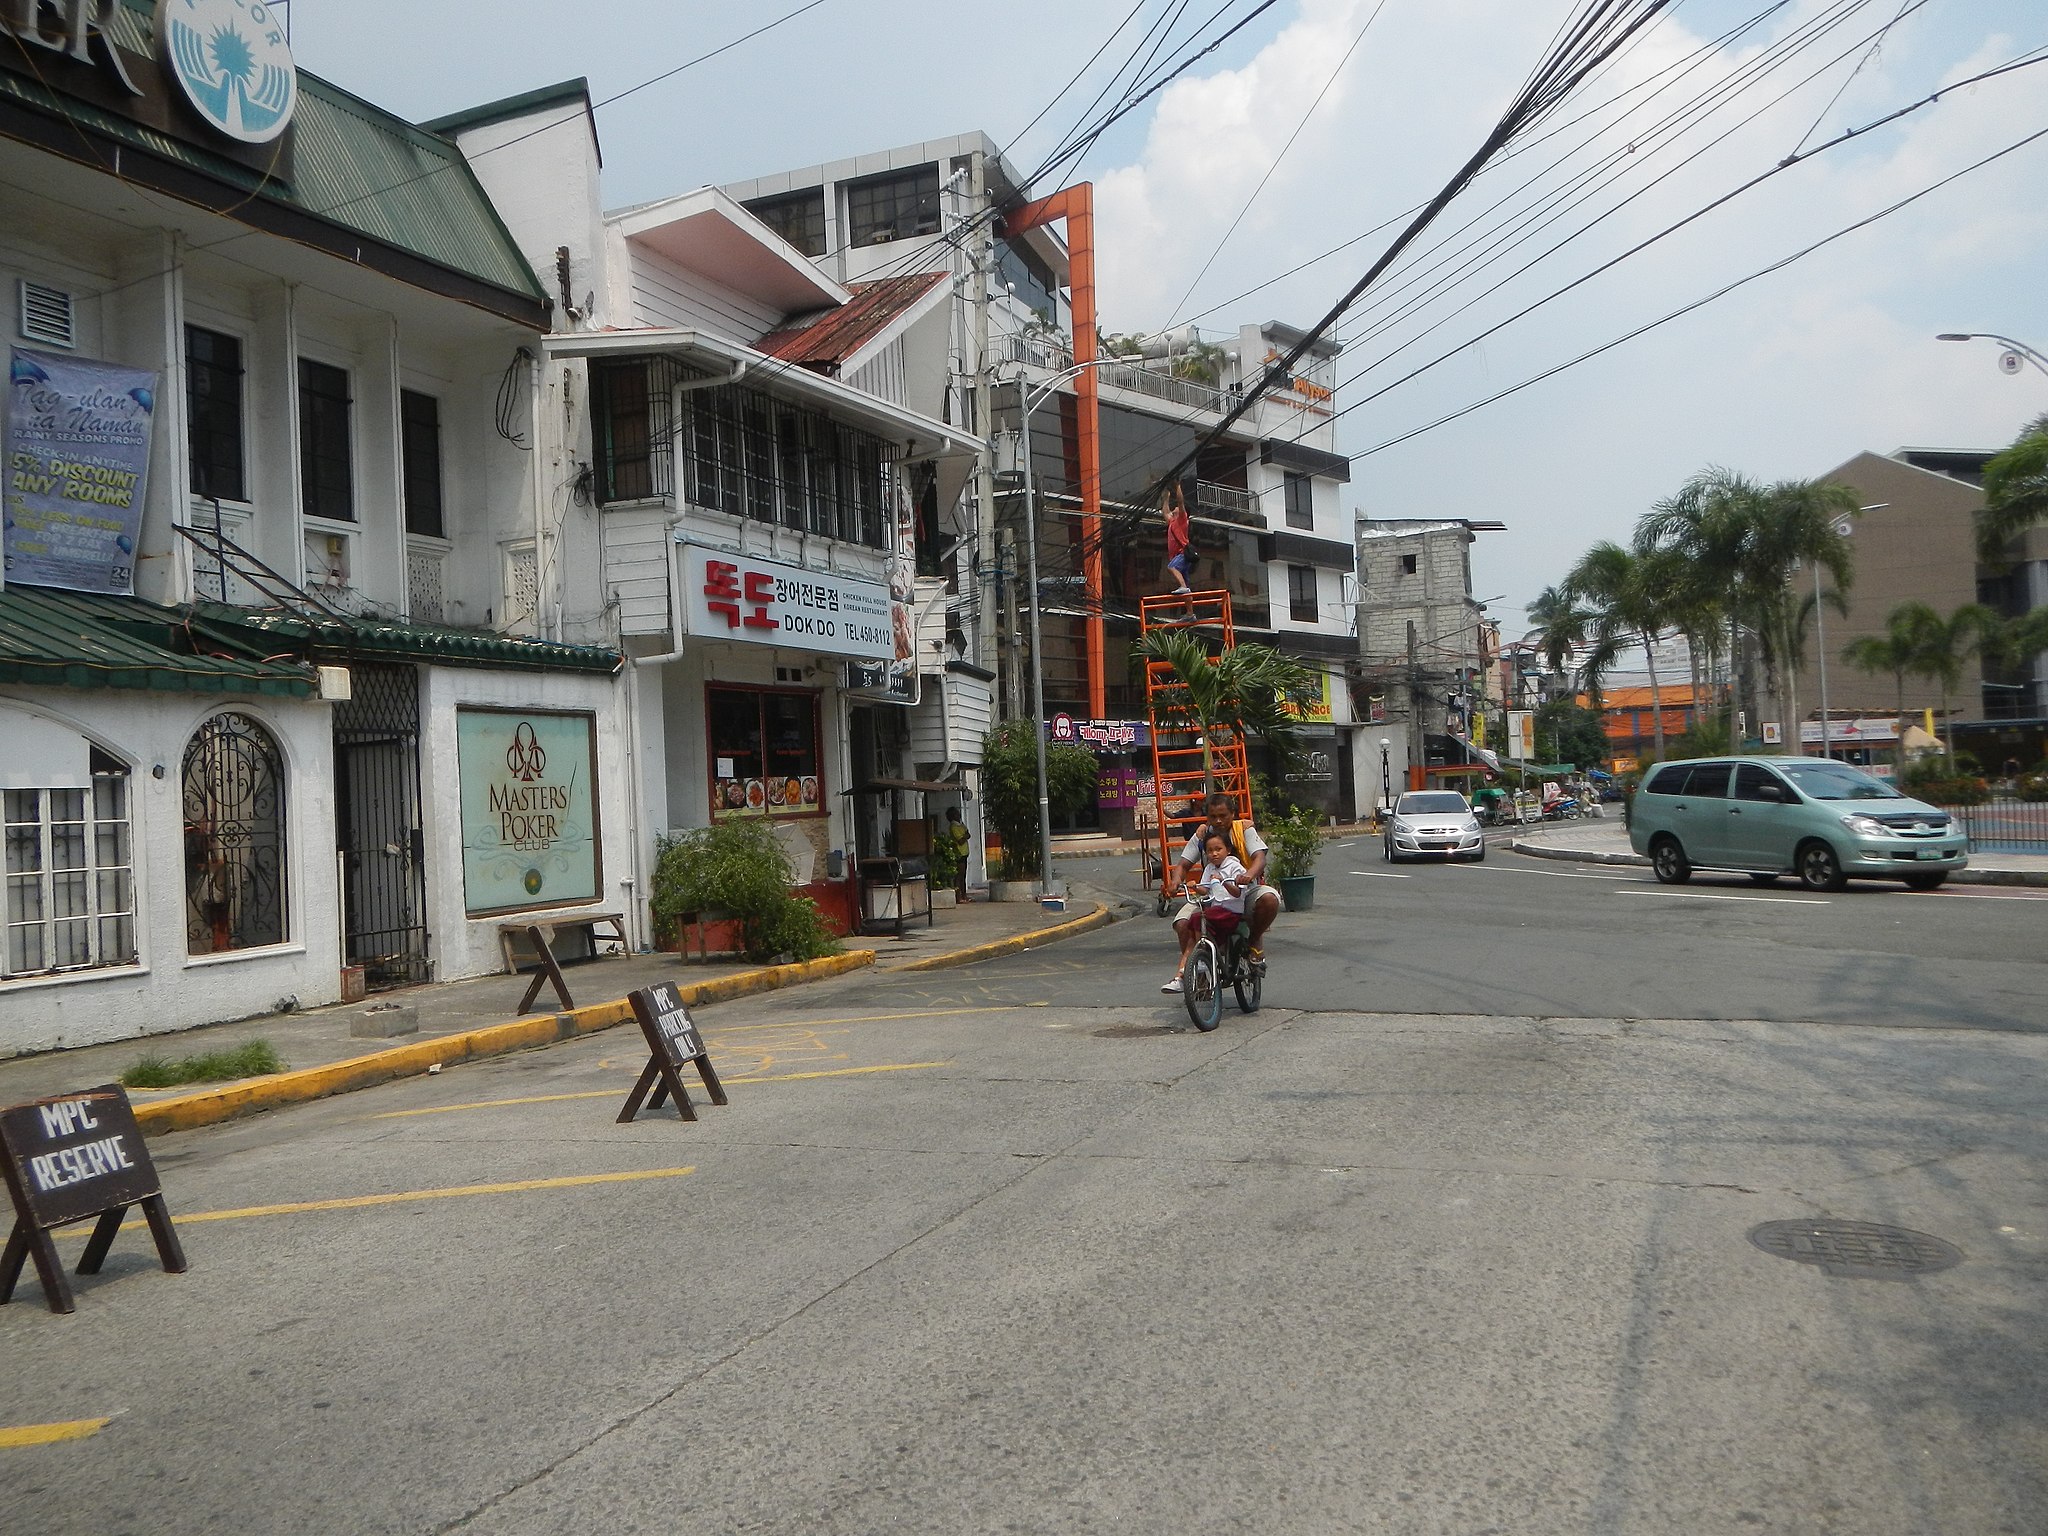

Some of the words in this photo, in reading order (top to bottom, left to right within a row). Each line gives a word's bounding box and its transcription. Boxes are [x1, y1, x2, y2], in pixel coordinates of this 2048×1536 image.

[66, 406, 144, 433] Naman
[13, 429, 52, 441] RAINY
[56, 431, 108, 444] SEASONS
[110, 434, 143, 446] PROMO
[49, 459, 140, 489] DISCOUNT
[11, 471, 58, 495] ANY
[62, 480, 133, 508] ROOMS
[111, 567, 130, 579] 24
[703, 559, 780, 629] 독도
[775, 578, 839, 613] 장어전문점
[784, 613, 814, 635] DOK
[817, 619, 836, 637] DO
[844, 622, 860, 641] TEL
[860, 625, 891, 646] 450-8112
[489, 783, 568, 813] MASTERS
[501, 811, 559, 841] POKER
[513, 838, 550, 852] CLUB
[652, 987, 675, 1013] MPC
[658, 1008, 693, 1039] PARKING
[673, 1033, 698, 1060] ONLY
[39, 1099, 99, 1139] MPC
[31, 1134, 135, 1192] RESERVE
